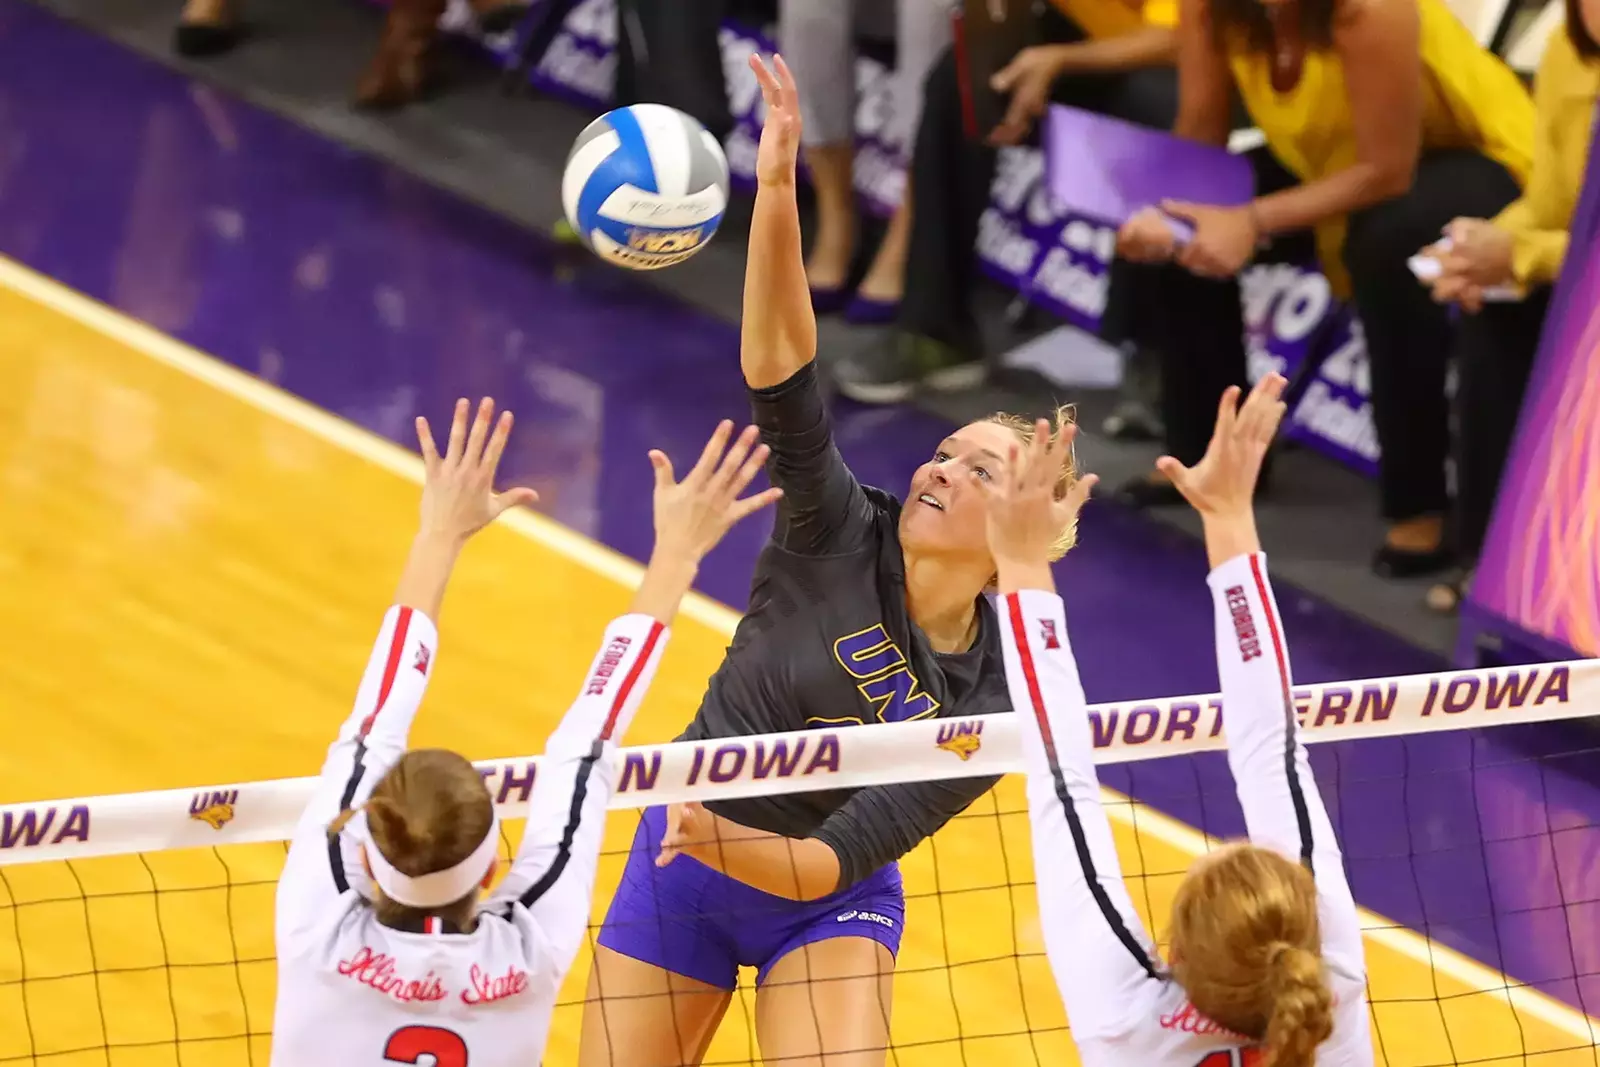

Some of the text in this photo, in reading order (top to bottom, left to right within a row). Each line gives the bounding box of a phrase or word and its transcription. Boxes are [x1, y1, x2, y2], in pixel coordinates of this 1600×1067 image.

[833, 622, 941, 724] UN
[1421, 665, 1571, 717] IOWA
[936, 720, 984, 745] UNI
[686, 734, 840, 787] IOWA
[189, 789, 239, 814] UNI
[337, 945, 530, 1005] Illinois State
